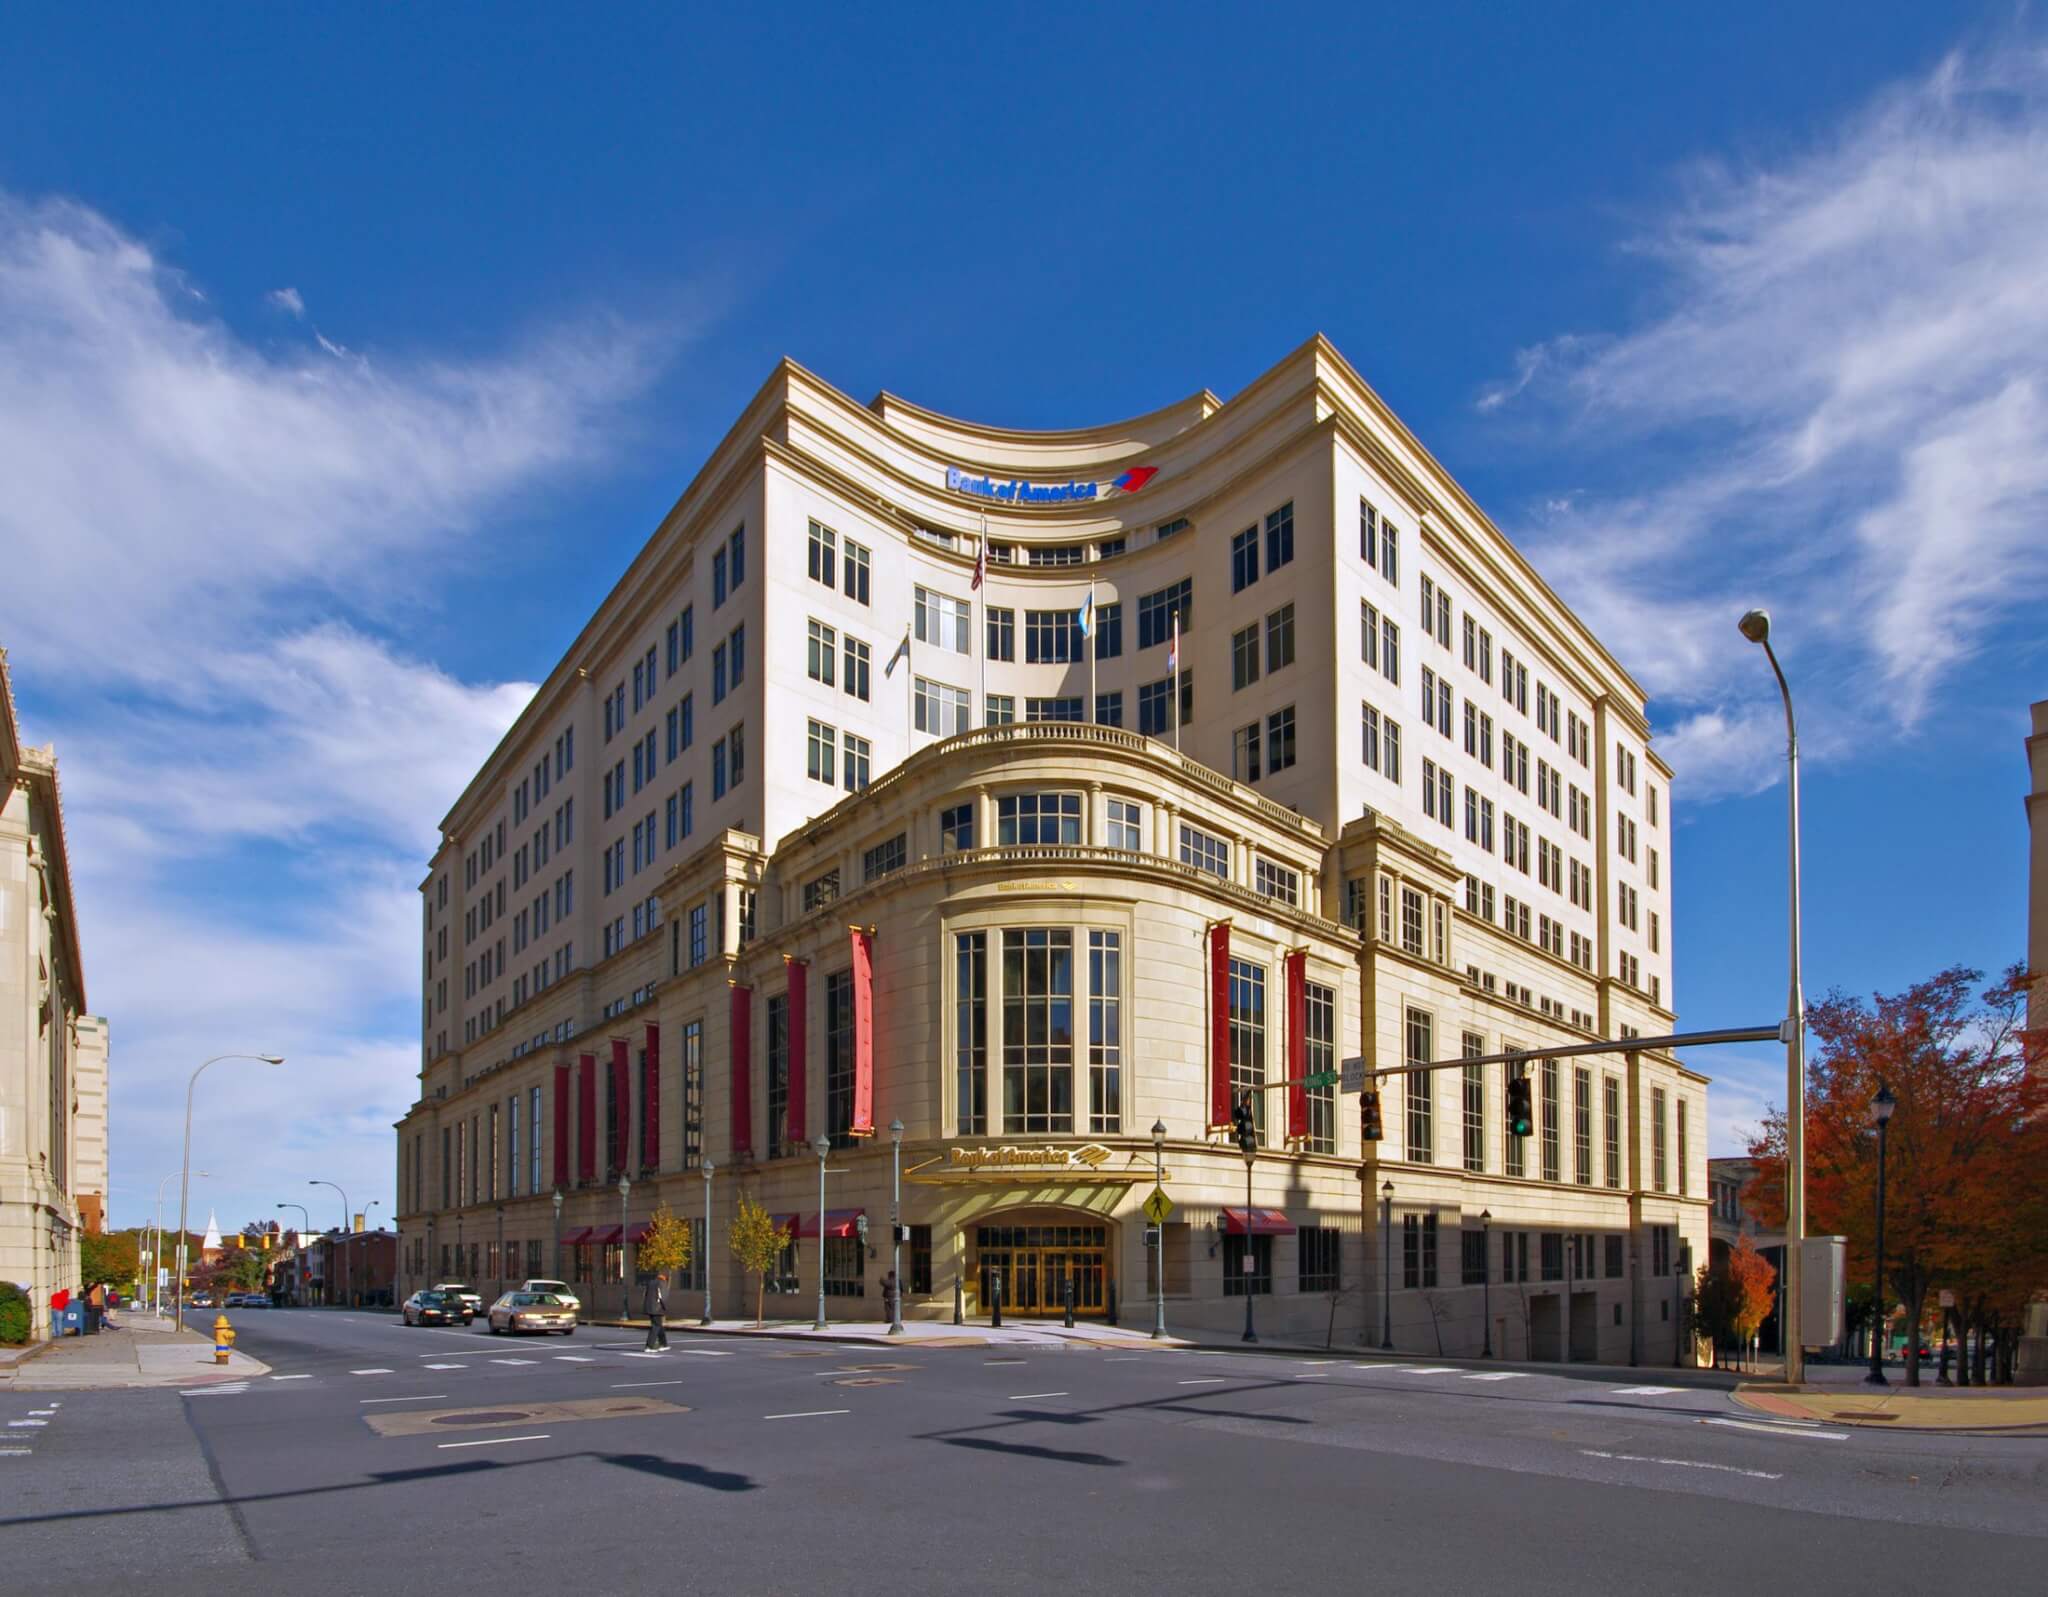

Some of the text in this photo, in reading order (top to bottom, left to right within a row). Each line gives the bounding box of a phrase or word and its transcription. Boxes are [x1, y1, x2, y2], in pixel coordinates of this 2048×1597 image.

[946, 465, 1097, 502] Bank of America
[951, 1146, 1069, 1164] Bank of America
